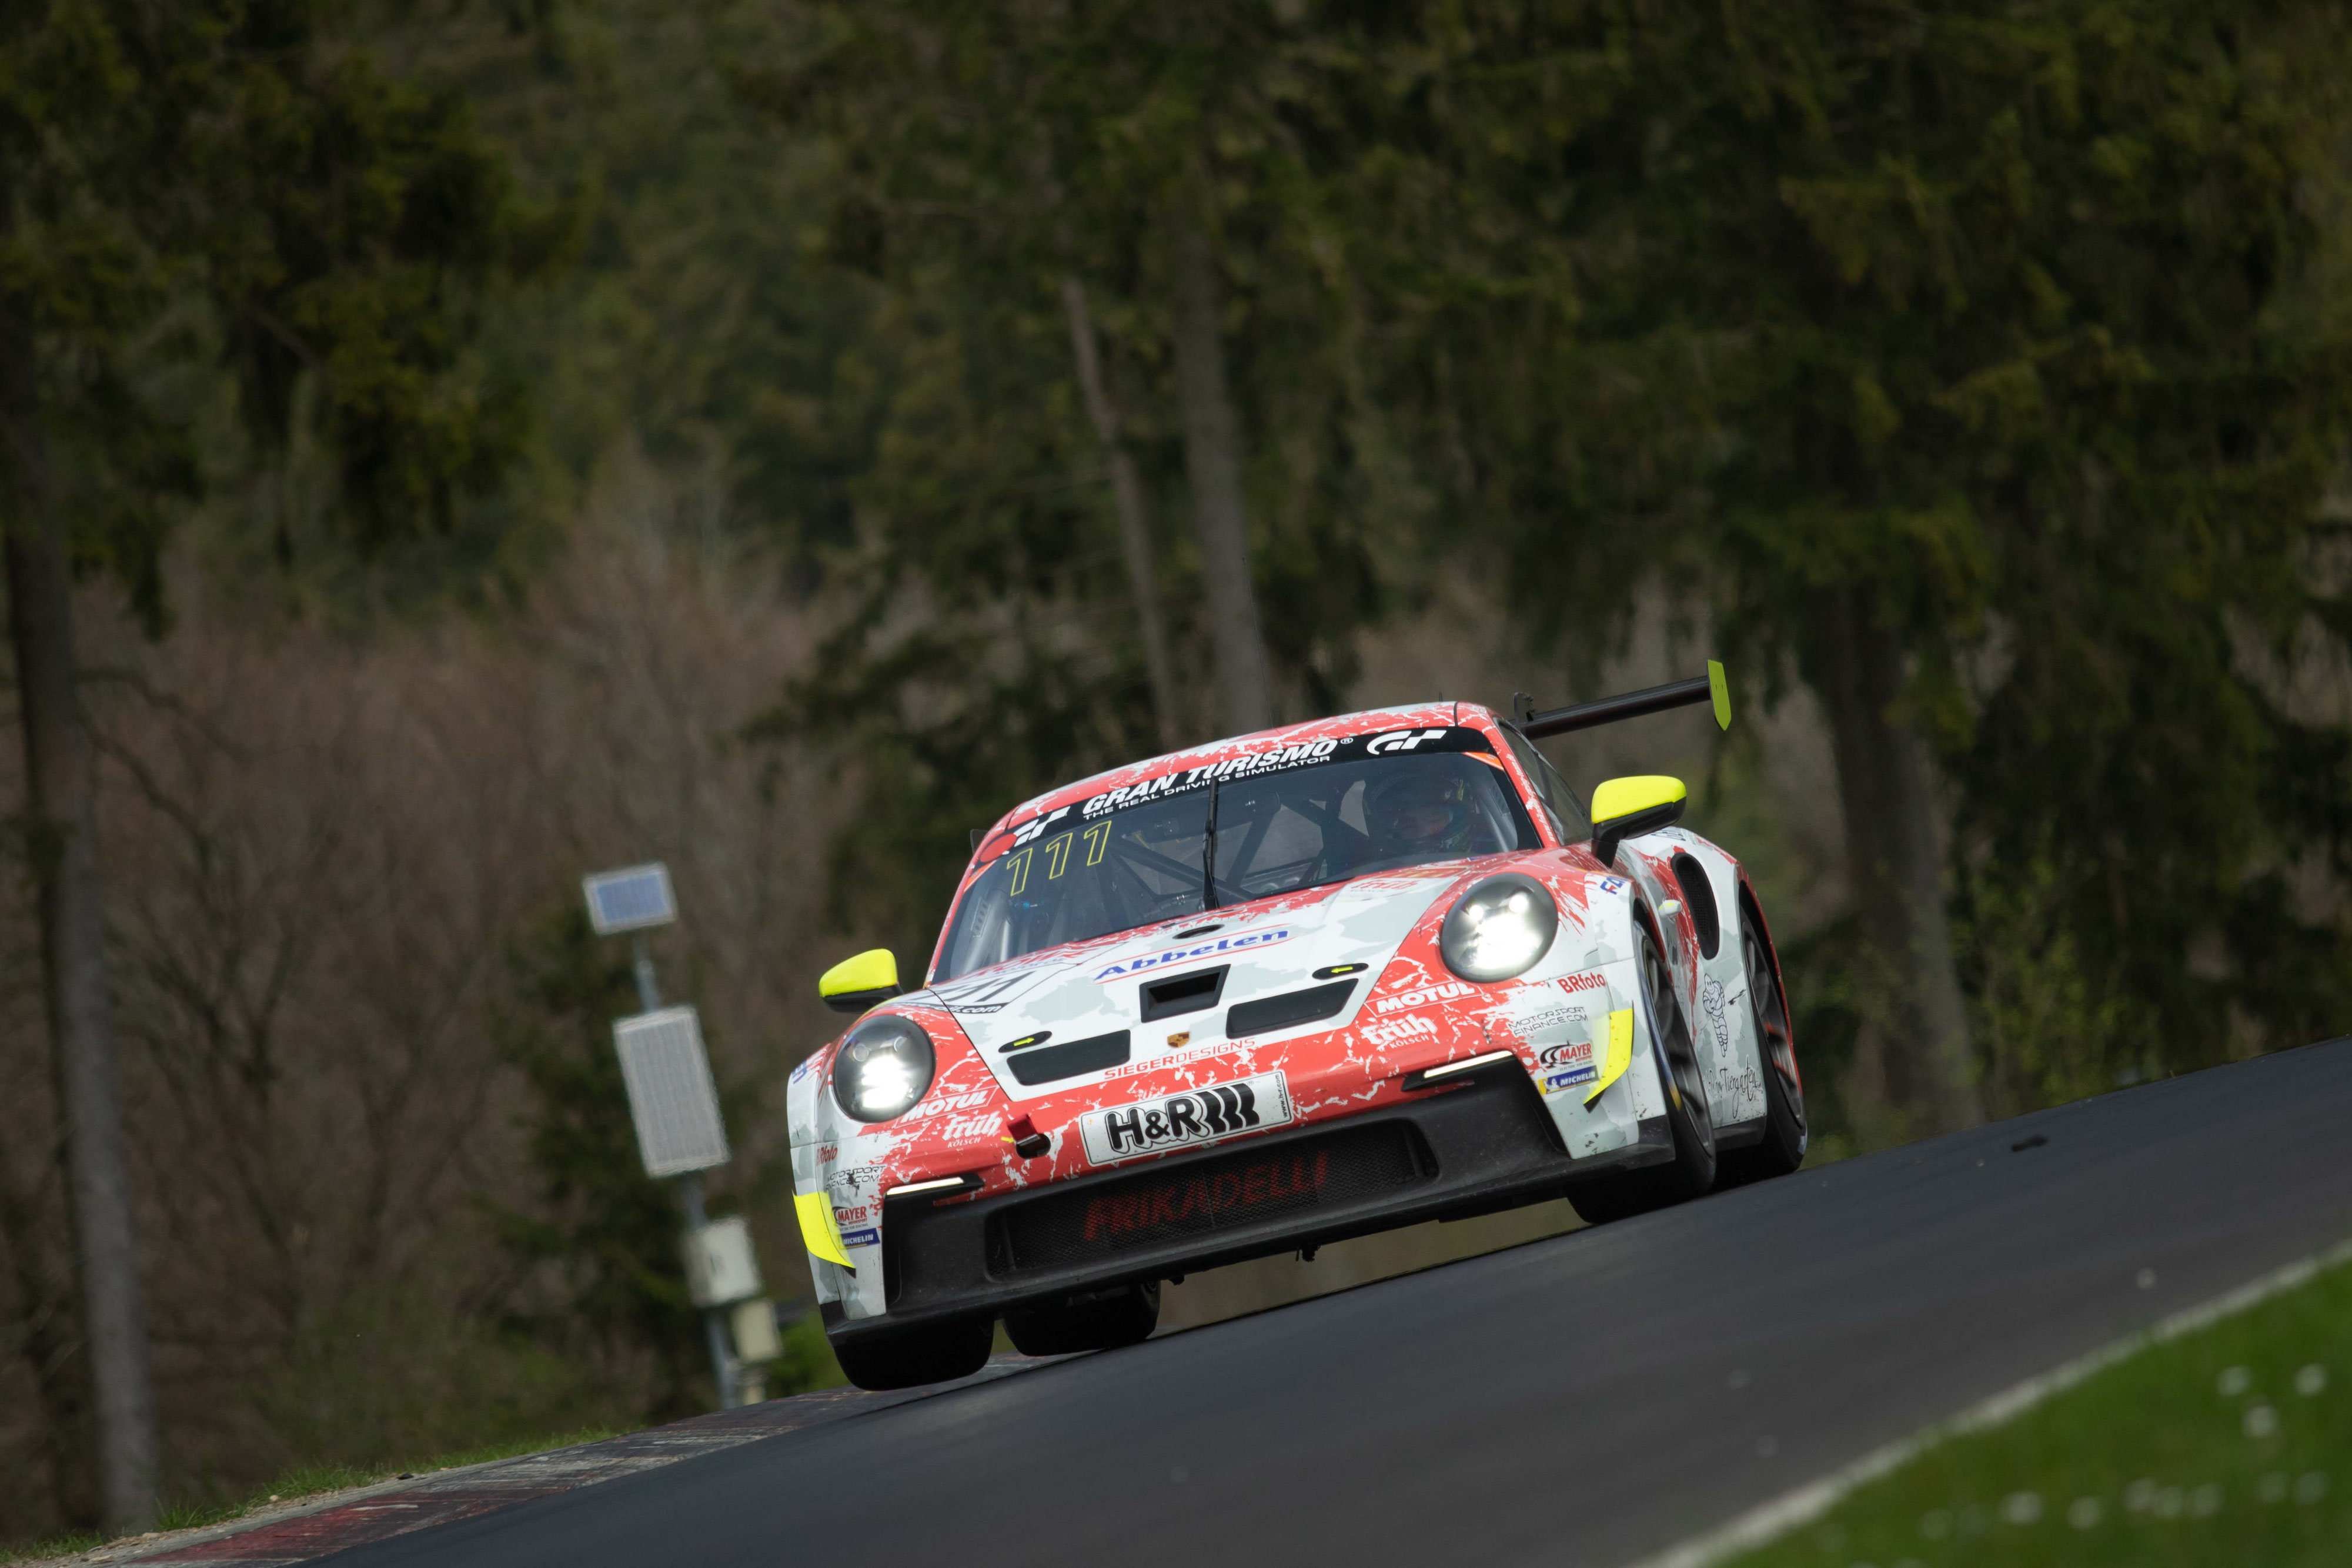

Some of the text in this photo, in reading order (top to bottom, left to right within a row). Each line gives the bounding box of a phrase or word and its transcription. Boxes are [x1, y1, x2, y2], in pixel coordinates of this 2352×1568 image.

[1083, 740, 1338, 815] GRAN TURISMO
[1084, 807, 1114, 821] THE
[1119, 794, 1160, 810] REAL
[1235, 755, 1330, 779] SIMULATOR
[1006, 820, 1112, 897] 111
[1094, 929, 1289, 981] Abbelen
[1556, 972, 1606, 994] BRfoto
[1377, 982, 1475, 1014] MOTUL
[1508, 1006, 1586, 1029] MOTORSPORT
[1514, 1014, 1589, 1037] FINANCE.COM
[1389, 1035, 1429, 1049] KÖLSCH
[1559, 1042, 1593, 1063] MAYER
[1104, 1037, 1257, 1081] SIEGERDESIGNS
[1560, 1070, 1596, 1087] MICHELIN
[900, 1091, 988, 1124] MOTUL
[1275, 1074, 1288, 1119] www.h-r.com
[947, 1136, 981, 1149] KÖLSCH
[837, 1206, 867, 1223] MAYER
